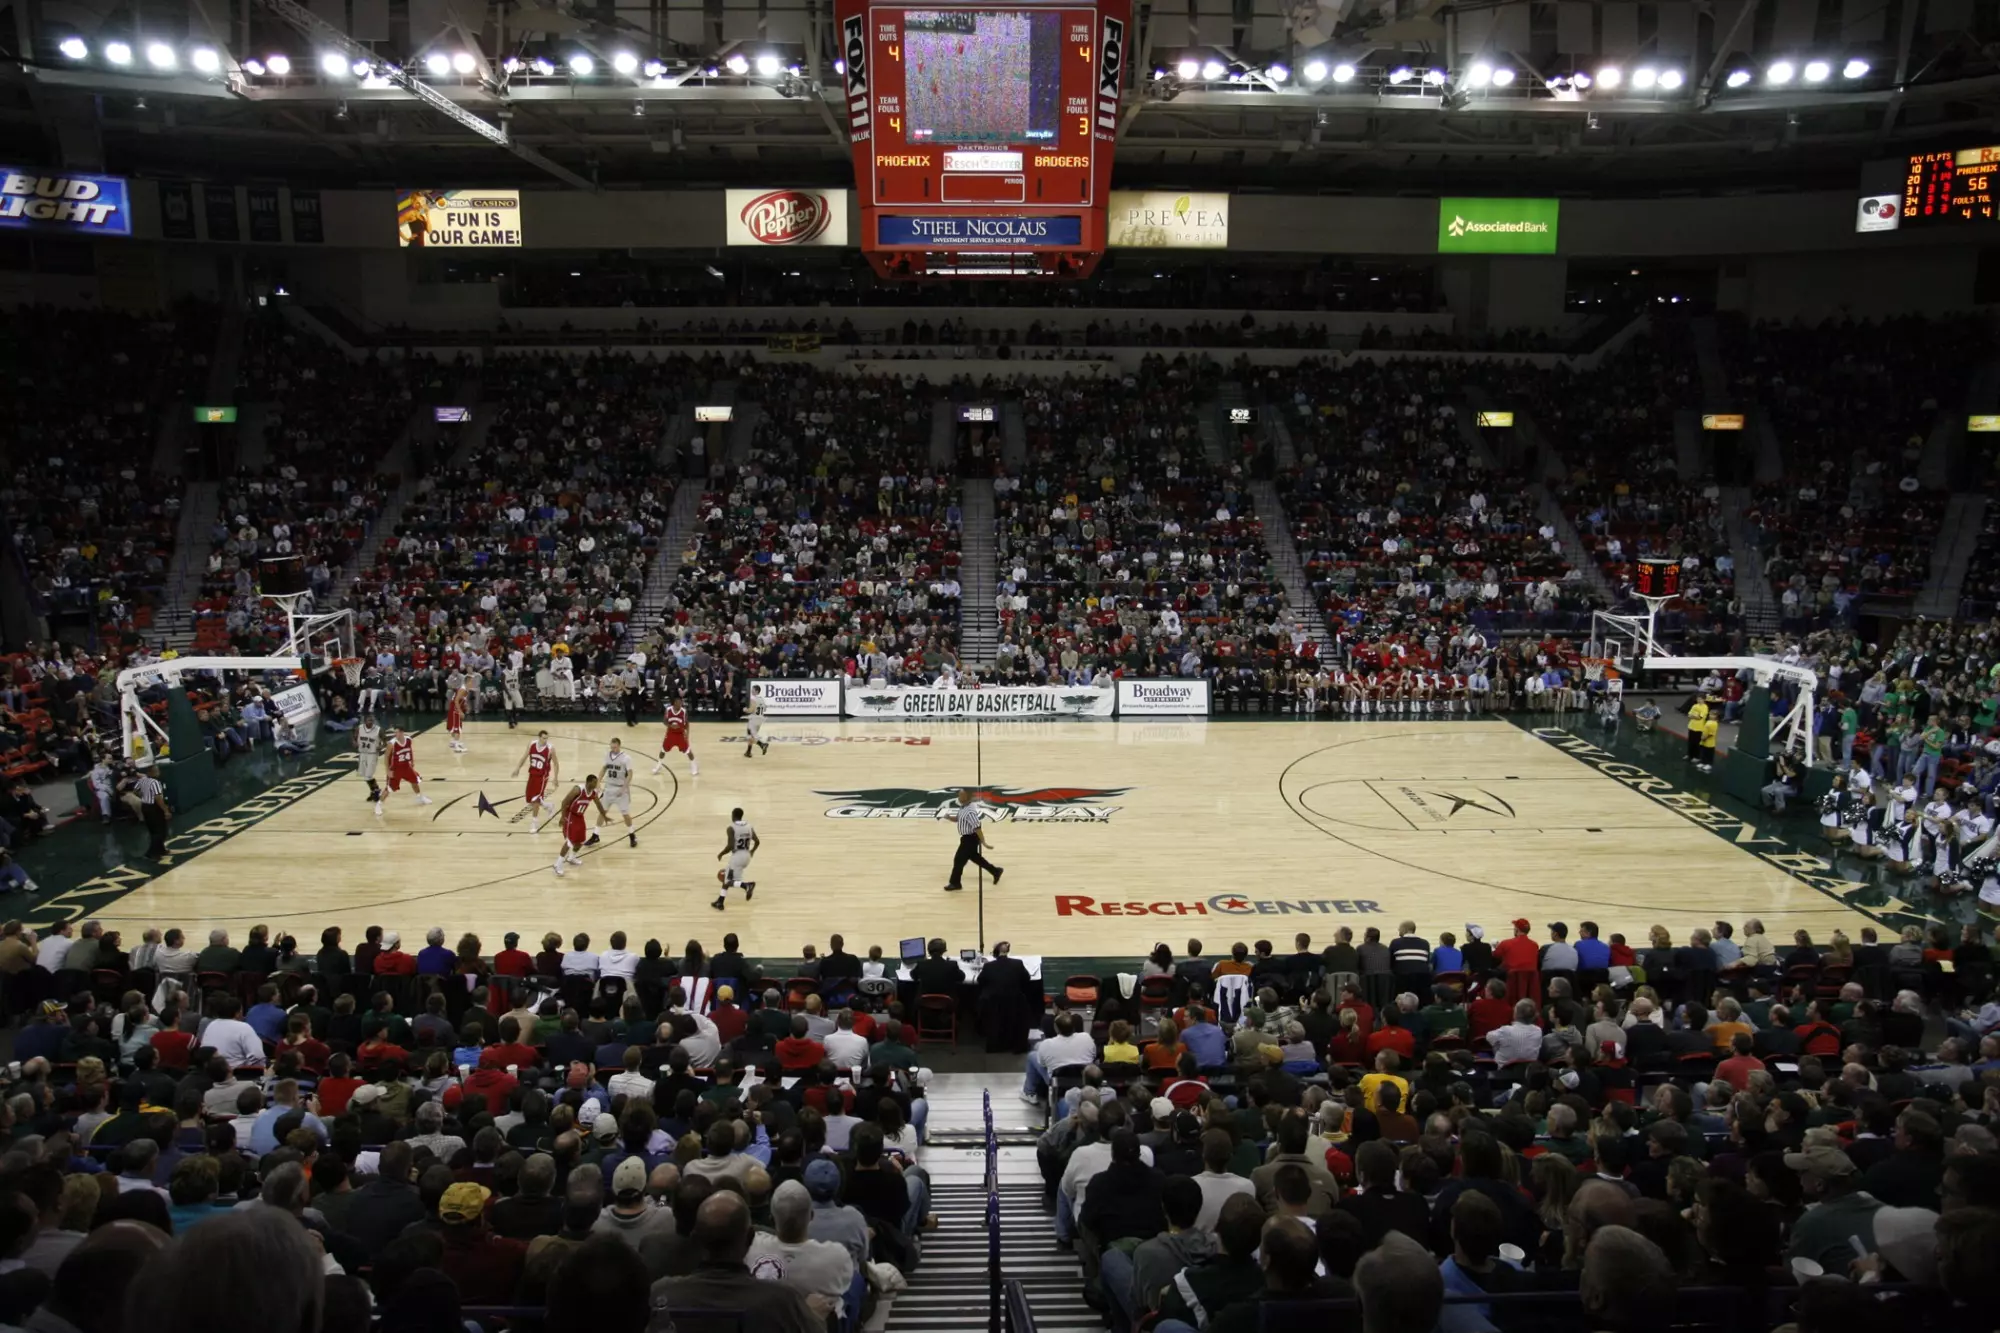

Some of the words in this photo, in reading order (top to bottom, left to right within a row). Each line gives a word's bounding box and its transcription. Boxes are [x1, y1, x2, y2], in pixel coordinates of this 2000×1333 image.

[879, 33, 897, 41] OUTS
[1070, 34, 1089, 42] OUTS
[844, 17, 867, 94] FOX
[888, 45, 899, 62] 4
[1079, 47, 1090, 63] 4
[1100, 18, 1122, 95] FOX
[851, 96, 869, 127] 11
[878, 105, 899, 113] FOULS
[1066, 106, 1088, 114] FOULS
[1098, 101, 1116, 129] 11
[889, 118, 900, 133] 4
[1079, 118, 1089, 135] 3
[876, 155, 931, 167] PHOENIX
[943, 155, 980, 169] RESCH
[1034, 156, 1090, 168] BADGERS
[1937, 152, 1951, 161] PTS
[1911, 164, 1922, 174] 10
[1956, 164, 1998, 176] PHOENIX
[2, 174, 99, 200] BUD
[1907, 175, 1920, 185] 20
[1968, 177, 1988, 191] 56
[473, 199, 516, 208] CASINO
[1906, 196, 1918, 206] 34
[1952, 196, 1975, 206] FOULS
[774, 198, 798, 219] Dr
[1904, 206, 1917, 217] 50
[1962, 208, 1971, 219] 4
[1982, 206, 1991, 217] 4
[447, 213, 480, 227] FUN
[485, 213, 501, 227] IS
[758, 202, 814, 238] Pepper
[1128, 209, 1226, 227] PREVEA
[911, 218, 961, 236] STIFEL
[966, 219, 1048, 237] NICOLAUS
[1465, 221, 1524, 233] Associated
[1524, 221, 1548, 233] Bank
[429, 231, 464, 245] OUR
[469, 231, 520, 245] GAME!
[1176, 231, 1222, 243] health
[764, 684, 824, 698] Broadway
[1133, 684, 1192, 698] Broadway
[903, 694, 945, 712] GREEN
[948, 694, 974, 712] BAY
[976, 693, 1057, 712] BASKETBALL
[1010, 806, 1124, 818] BAY
[1758, 849, 1946, 926] BAY
[1054, 895, 1208, 916] RESCH
[1208, 894, 1387, 915] CENTER
[867, 982, 885, 992] 30
